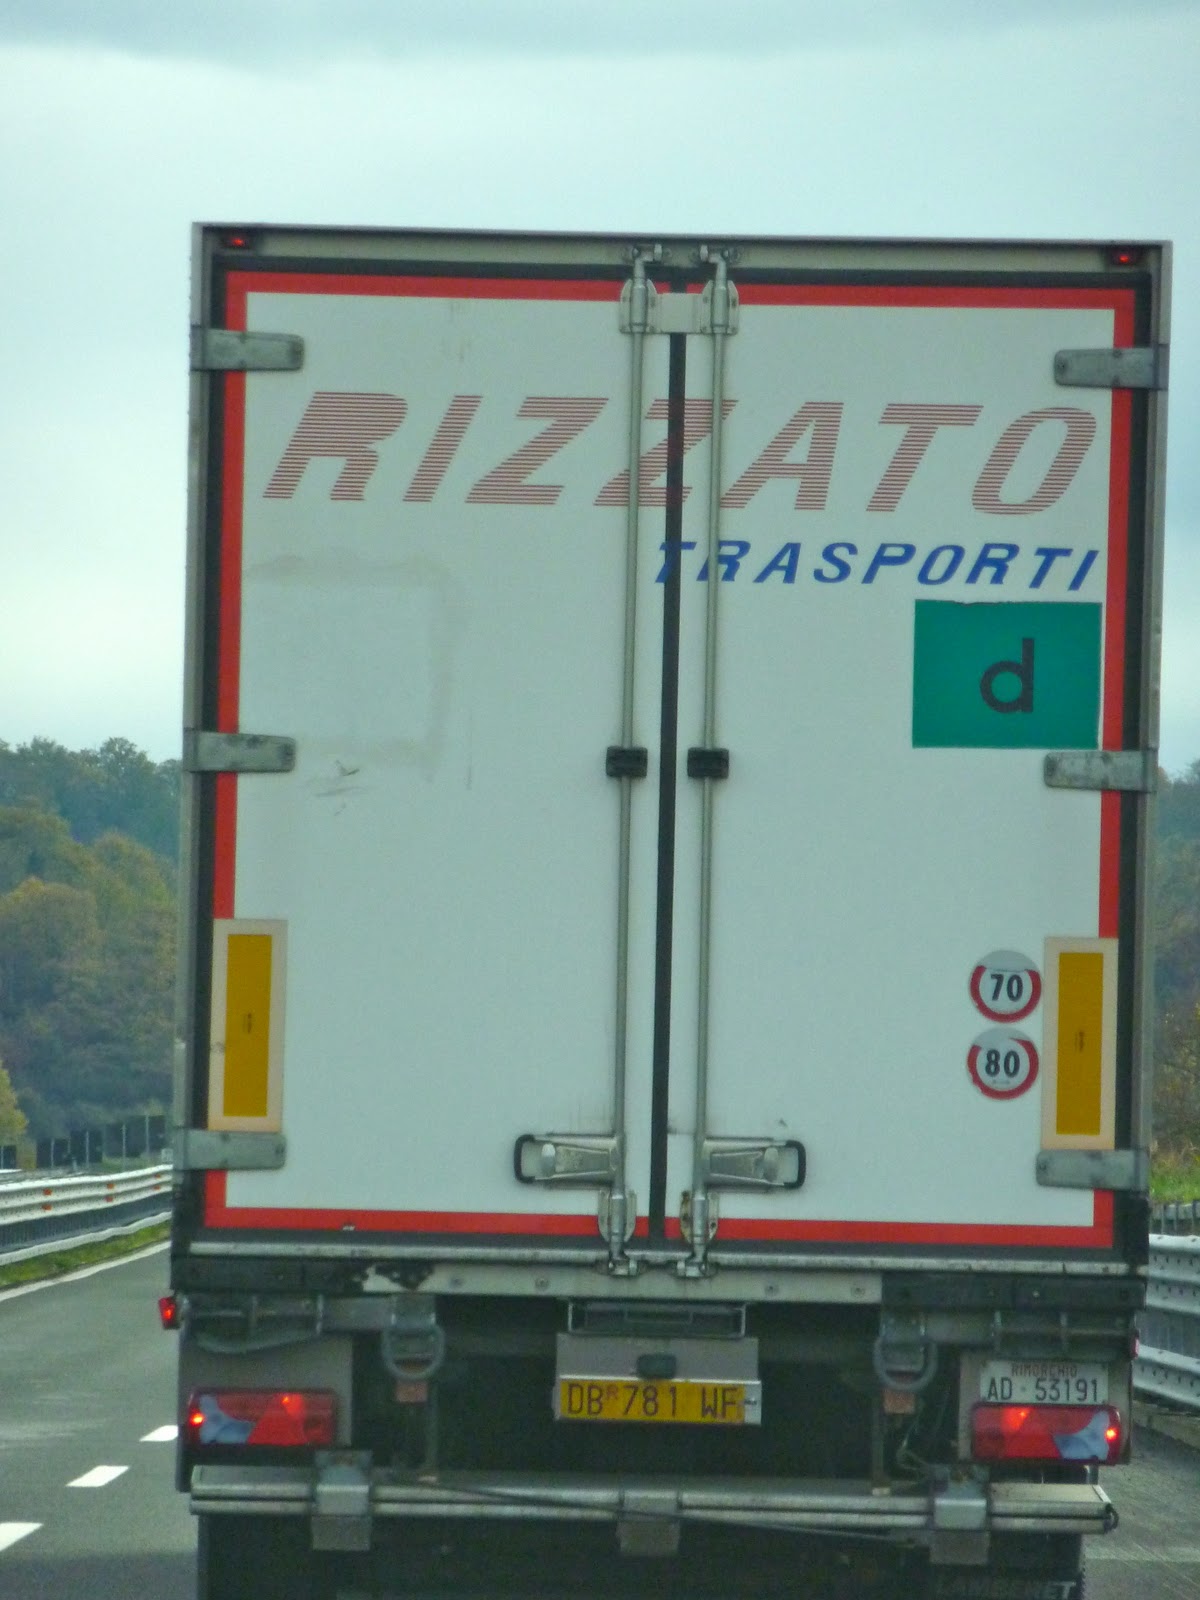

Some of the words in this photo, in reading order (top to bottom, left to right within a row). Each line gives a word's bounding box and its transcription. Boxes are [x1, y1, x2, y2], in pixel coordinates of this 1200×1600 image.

[262, 391, 1097, 515] RIZZATO
[655, 541, 1100, 591] TRASPORTI
[979, 638, 1035, 714] d
[990, 974, 1023, 1002] 70
[985, 1049, 1020, 1078] 80
[567, 1383, 603, 1415] DB
[622, 1384, 678, 1418] 781
[701, 1386, 739, 1419] WF
[988, 1376, 1012, 1400] AD
[1035, 1378, 1098, 1401] 53191
